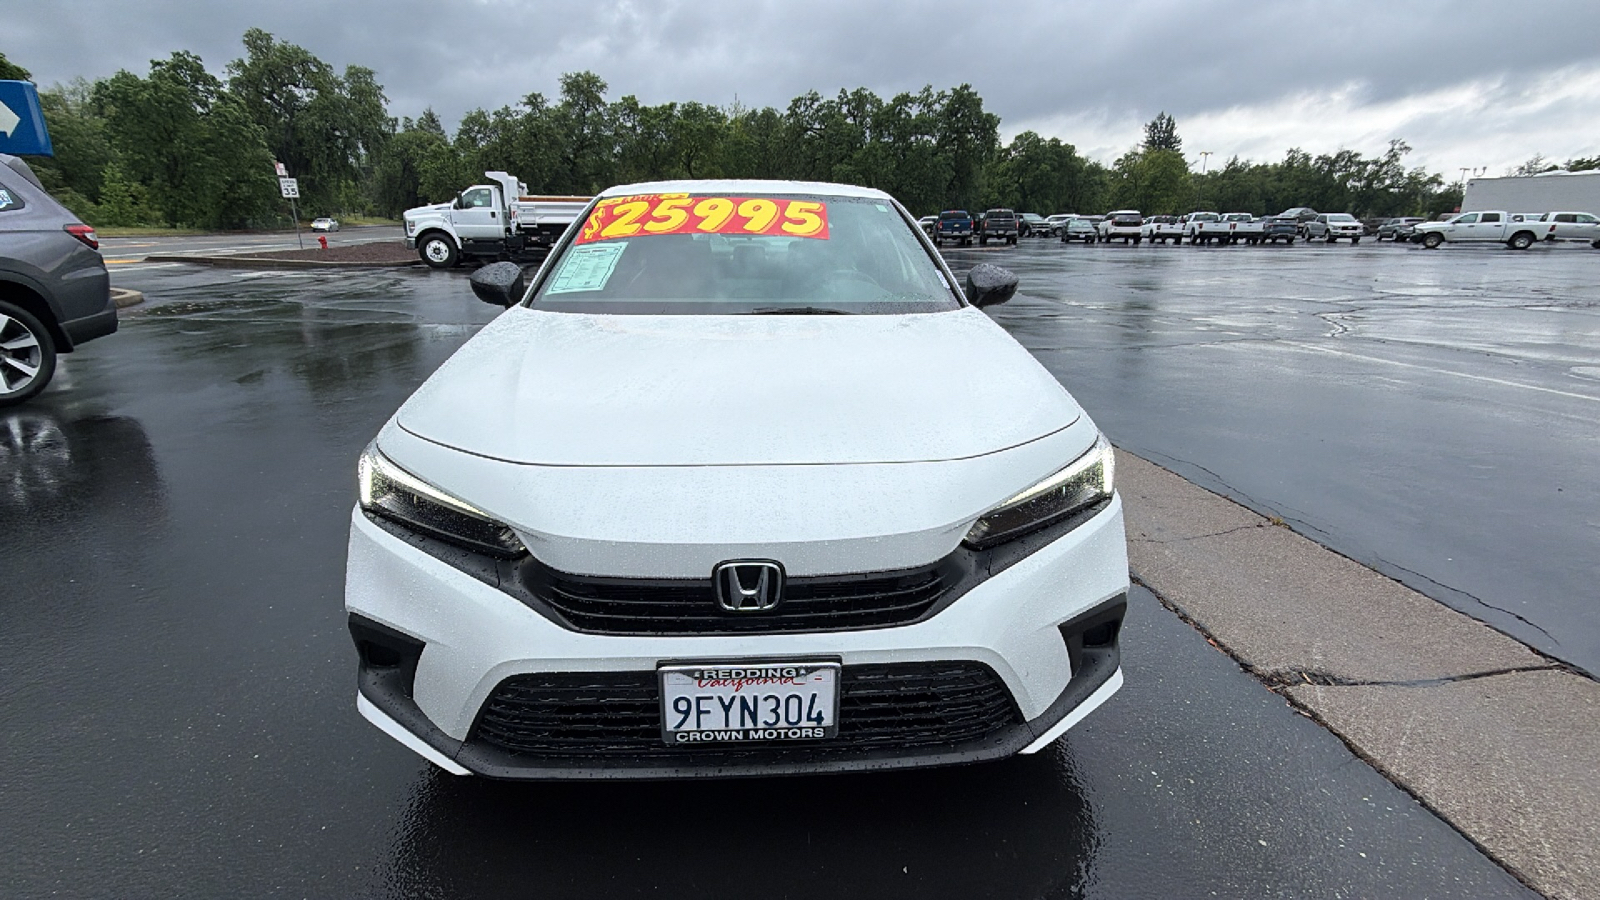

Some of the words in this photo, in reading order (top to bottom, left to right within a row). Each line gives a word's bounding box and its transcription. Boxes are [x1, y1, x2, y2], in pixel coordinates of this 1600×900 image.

[584, 197, 825, 240] $25995
[703, 667, 797, 679] REDDING
[673, 693, 824, 729] 9FYN304
[676, 730, 744, 742] CROWN
[749, 728, 825, 740] MOTORS
